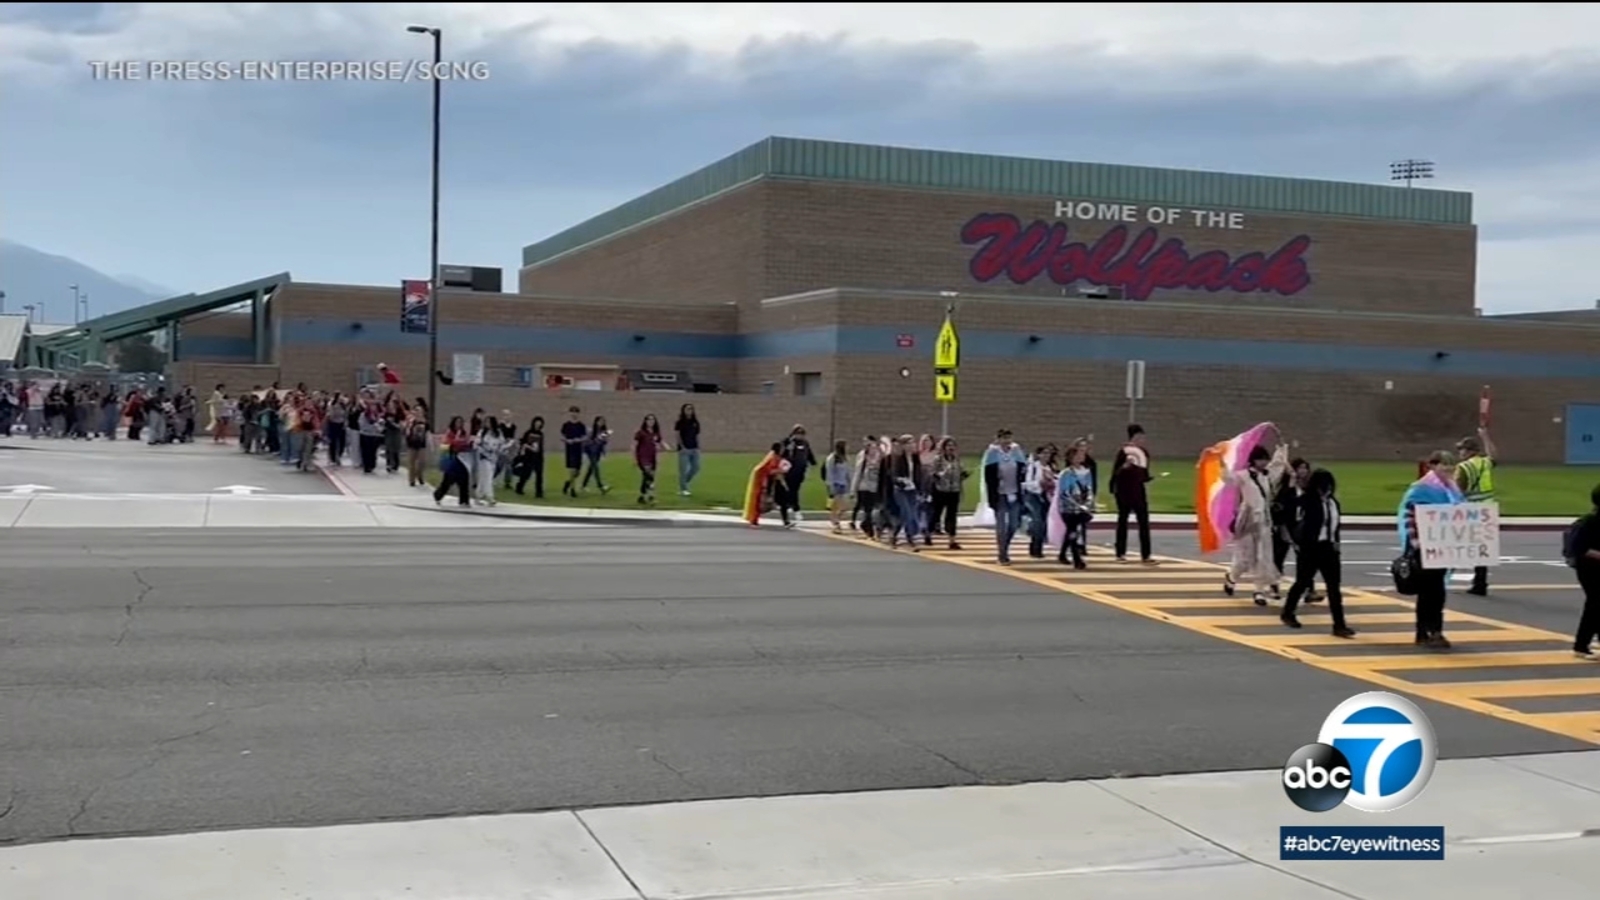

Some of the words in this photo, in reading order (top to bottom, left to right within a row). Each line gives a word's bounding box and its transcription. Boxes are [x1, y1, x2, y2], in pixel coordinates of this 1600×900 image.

[1054, 200, 1138, 222] HOME
[1146, 206, 1182, 224] OF
[1191, 209, 1245, 230] THE
[960, 212, 1312, 300] Wolfpack
[1426, 508, 1491, 522] TRANS
[1427, 522, 1495, 543] LIVES
